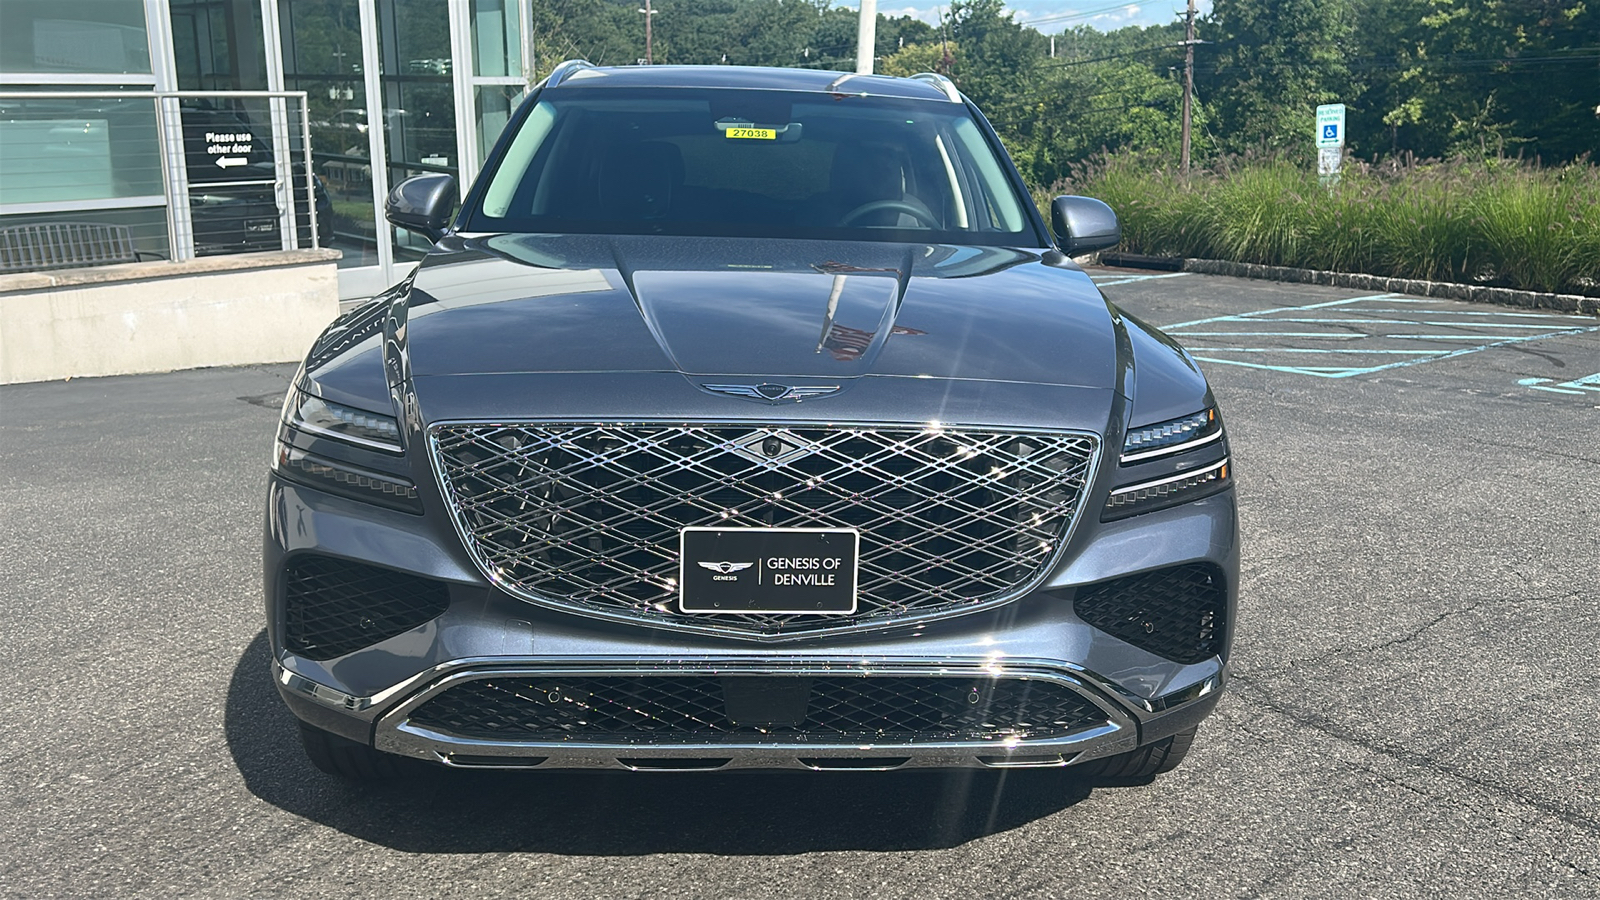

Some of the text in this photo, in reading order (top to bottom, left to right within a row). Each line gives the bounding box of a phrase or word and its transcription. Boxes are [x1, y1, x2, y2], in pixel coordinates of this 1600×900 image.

[205, 132, 251, 142] Please use
[733, 129, 768, 138] 27038
[207, 143, 252, 154] other door
[766, 557, 842, 570] GENESIS OF
[774, 573, 836, 586] DENVILLE
